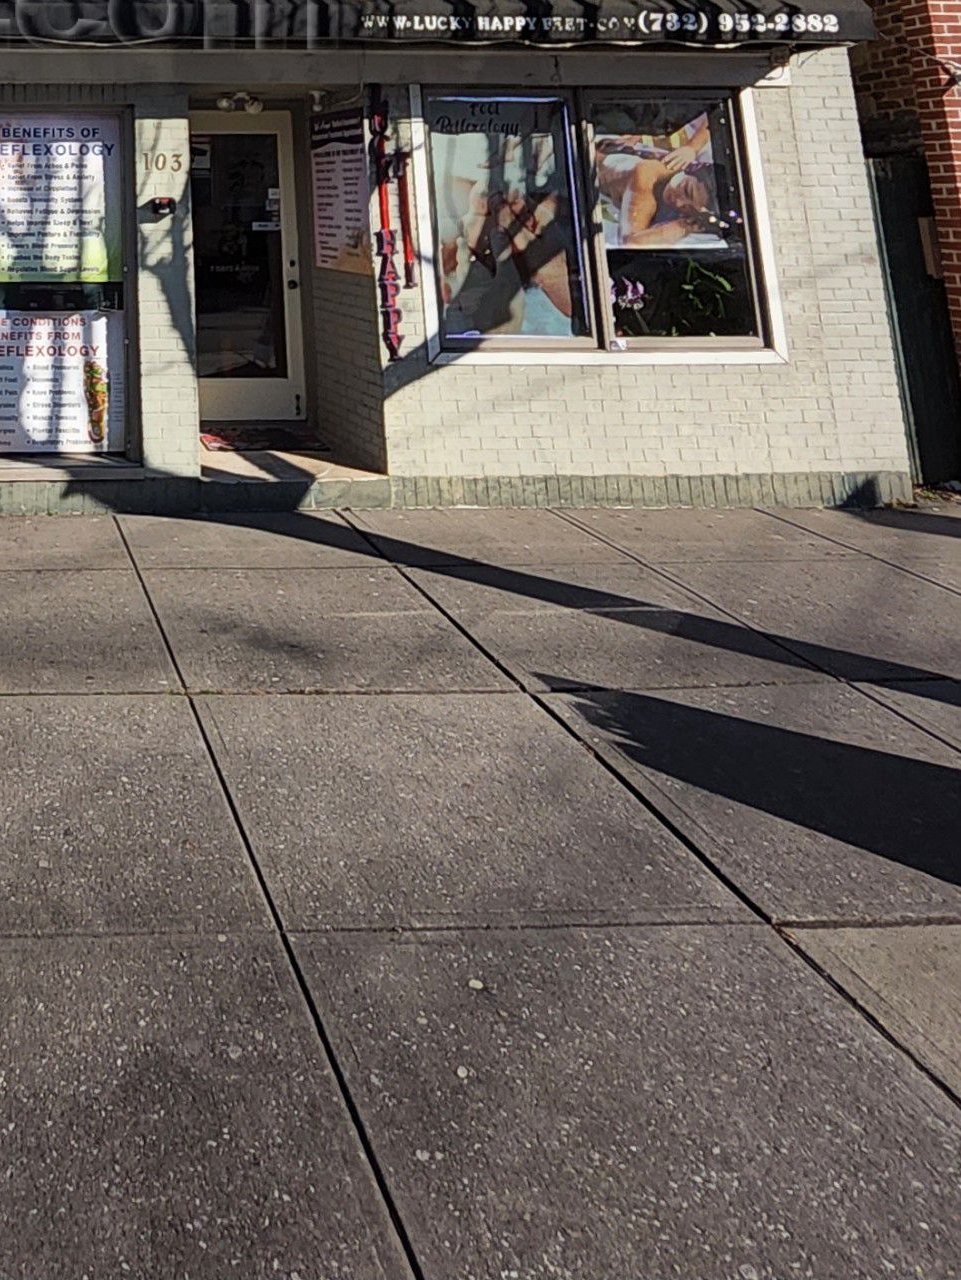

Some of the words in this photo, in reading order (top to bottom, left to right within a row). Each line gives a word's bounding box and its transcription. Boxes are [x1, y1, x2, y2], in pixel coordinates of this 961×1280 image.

[1, 127, 75, 139] BENEFITS
[81, 127, 100, 138] OF
[142, 152, 183, 172] 103
[12, 317, 87, 327] CONDITIONS
[47, 331, 81, 341] FROM
